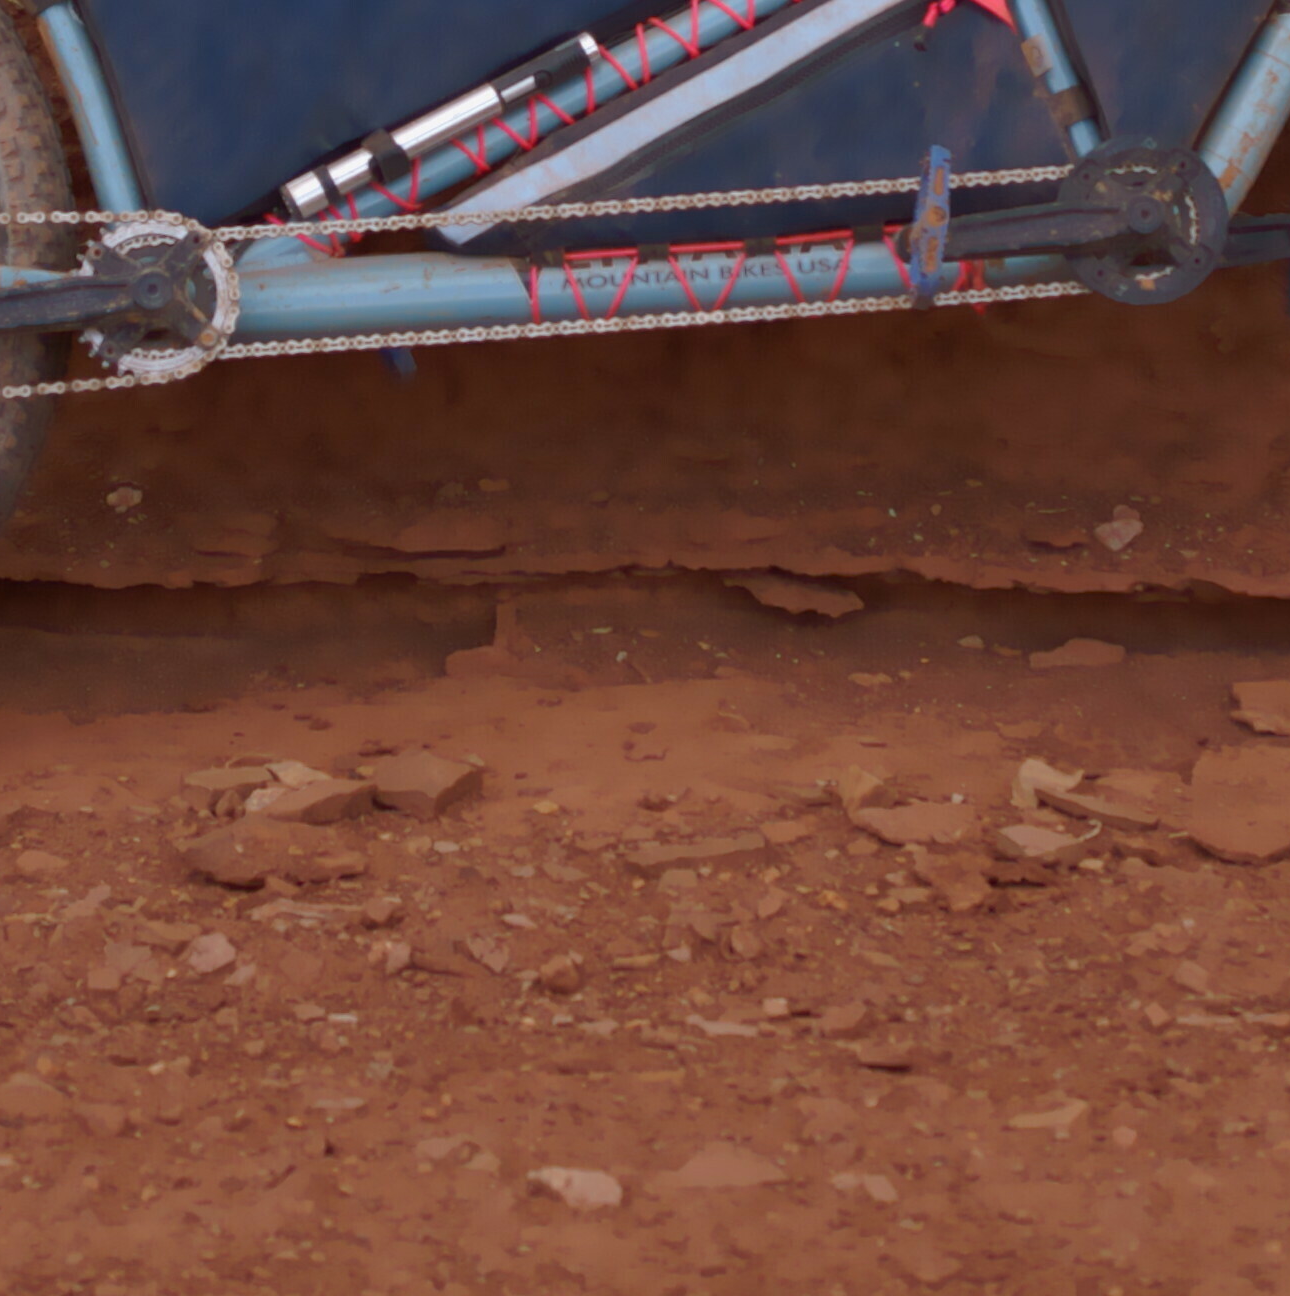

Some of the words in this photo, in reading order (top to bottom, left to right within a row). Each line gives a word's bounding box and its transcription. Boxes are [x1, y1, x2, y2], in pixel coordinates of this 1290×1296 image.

[561, 265, 710, 291] MOUNTAIN
[719, 260, 786, 281] BIKES
[795, 256, 852, 275] USA
